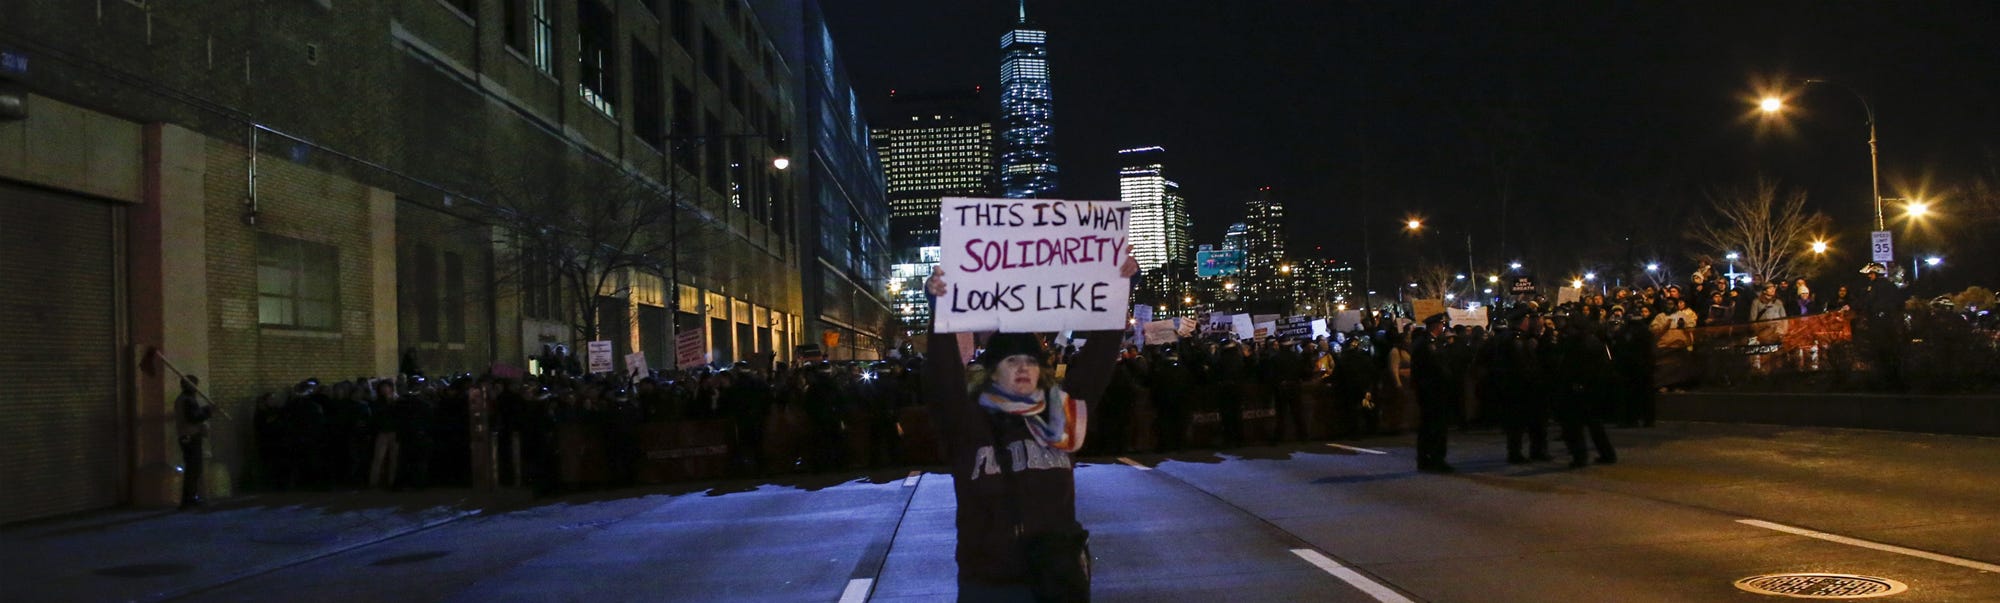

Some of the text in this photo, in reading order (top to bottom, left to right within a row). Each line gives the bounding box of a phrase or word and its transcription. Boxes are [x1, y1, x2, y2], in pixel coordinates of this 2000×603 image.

[954, 201, 1132, 231] THIS IS WHAT
[960, 235, 1125, 272] SOLIDARITY
[1874, 243, 1890, 253] 35
[951, 282, 1110, 313] LOOKS LIKE
